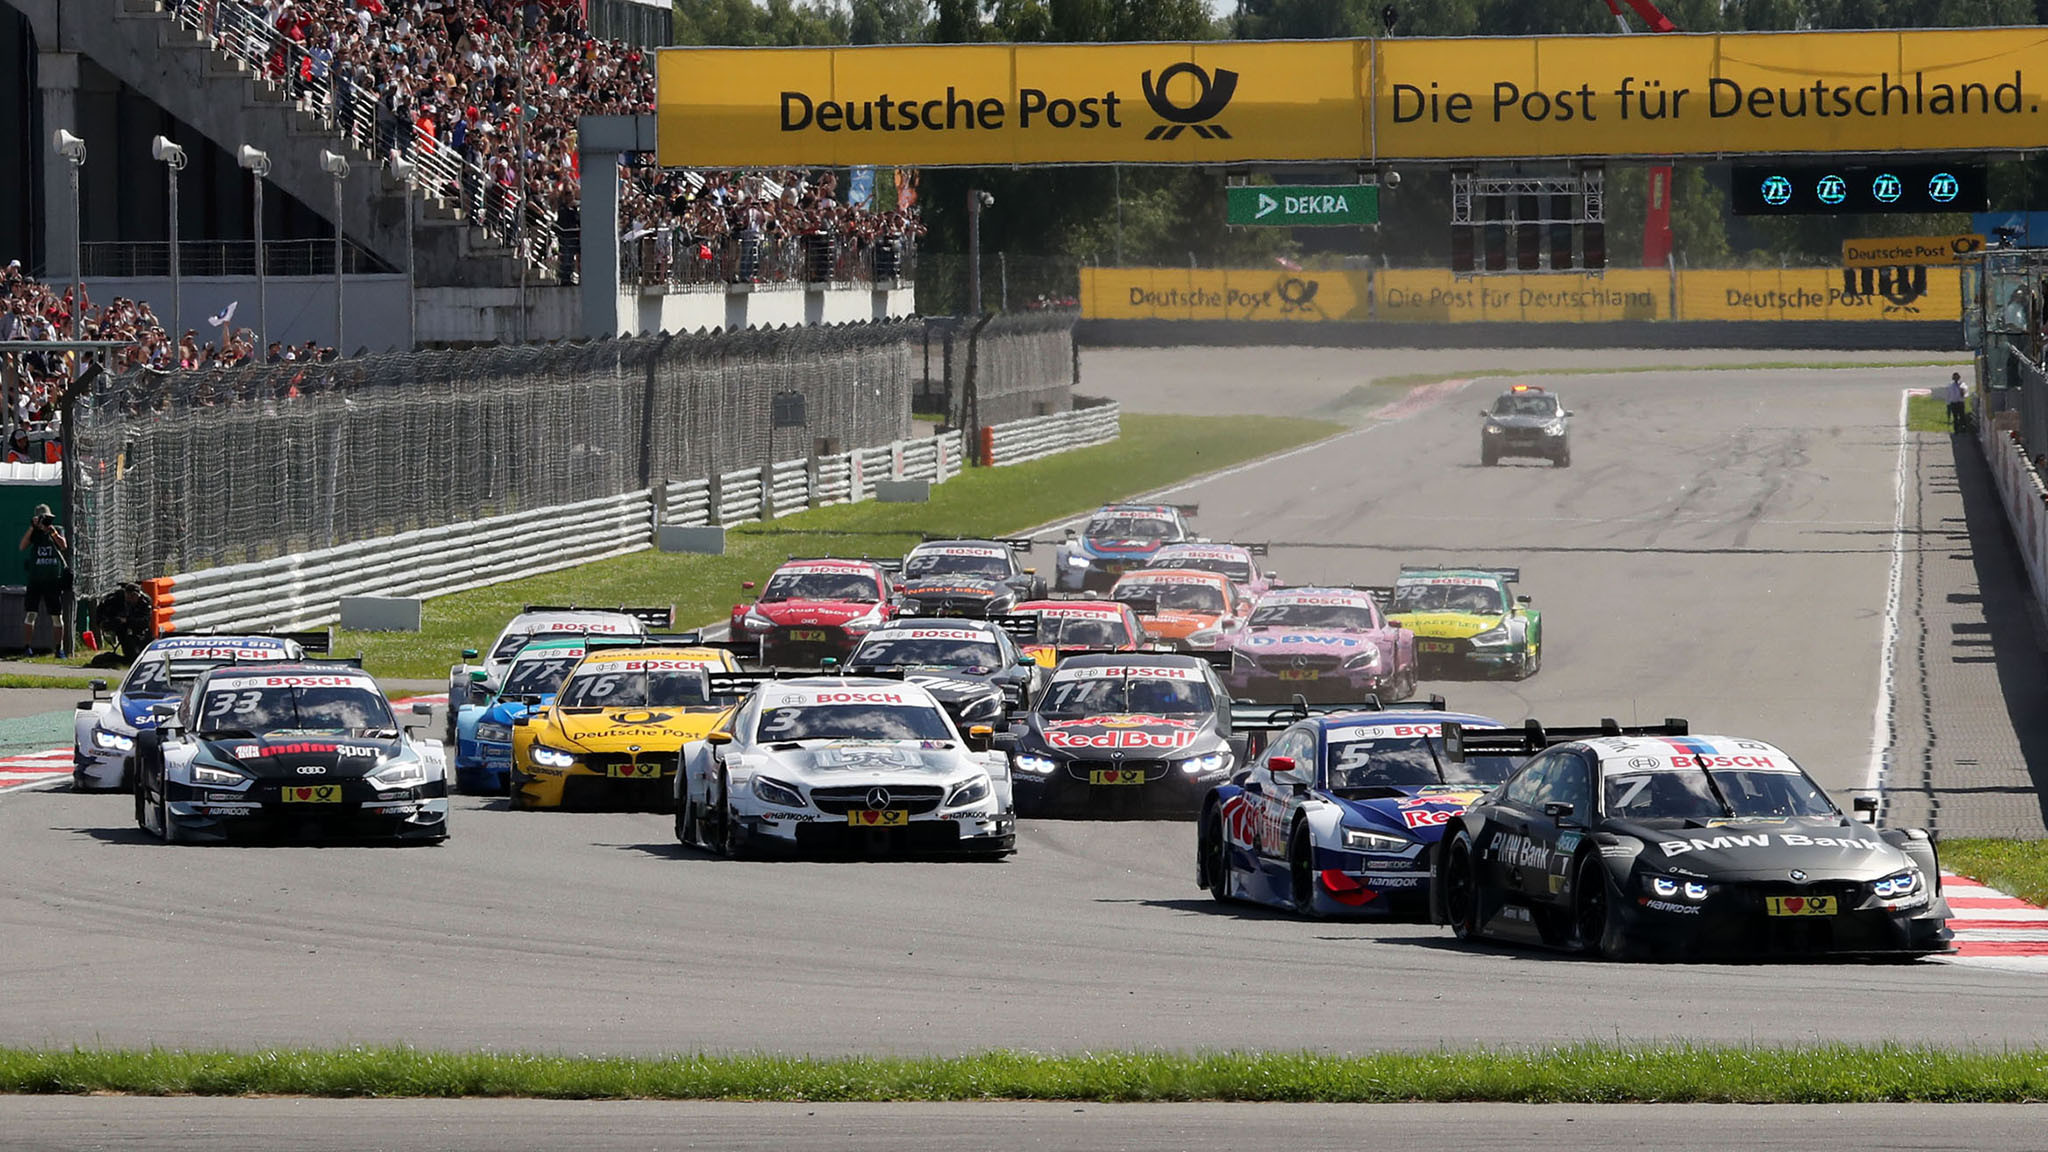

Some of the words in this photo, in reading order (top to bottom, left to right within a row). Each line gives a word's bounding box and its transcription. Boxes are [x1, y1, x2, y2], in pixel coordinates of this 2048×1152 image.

[1393, 81, 1473, 124] Die
[1493, 81, 1597, 123] Post
[1614, 74, 1690, 121] für
[1708, 70, 2040, 119] Deutschland.
[780, 86, 1005, 132] Deutsche
[1020, 88, 1122, 129] Post
[1285, 194, 1349, 215] DEKRA
[1847, 245, 1912, 261] Deutsche
[1915, 245, 1946, 258] Post
[1129, 286, 1221, 308] Deutsche
[1226, 287, 1272, 308] Post
[1387, 287, 1423, 309] Die
[1430, 287, 1473, 308] Post
[1481, 286, 1511, 308] für
[1519, 286, 1656, 309] Deutschland
[1726, 287, 1823, 309] Deutsche
[1829, 287, 1873, 307] Post
[945, 548, 993, 556] BOSCH
[907, 556, 940, 570] 63
[808, 567, 862, 575] BOSCH
[772, 575, 803, 589] 51
[1154, 576, 1207, 585] BOSCH
[1117, 586, 1150, 599] 53
[1395, 585, 1428, 600] 99
[1296, 597, 1352, 606] BOSCH
[817, 607, 853, 617] Sport
[1046, 609, 1108, 620] BOSCH
[1254, 606, 1290, 623] 22
[551, 623, 616, 632] BOSCH
[911, 630, 977, 639] BOSCH
[157, 639, 243, 649] SAMSUNG
[247, 640, 278, 649] SDI
[1281, 634, 1359, 647] BWT
[191, 648, 269, 659] BOSCH
[860, 642, 894, 659] 6
[625, 661, 705, 671] BOSCH
[1105, 667, 1185, 678] BOSCH
[266, 677, 352, 687] BOSCH
[575, 674, 621, 699] 16
[816, 693, 903, 704] BOSCH
[1053, 681, 1097, 705] 11
[207, 691, 263, 717] 33
[764, 708, 802, 732] 3
[573, 728, 658, 741] Deutsche
[662, 728, 701, 739] Post
[1044, 730, 1118, 748] Red
[1121, 730, 1198, 748] Bull
[1335, 742, 1376, 771] 5
[1670, 755, 1775, 769] BOSCH
[1614, 775, 1653, 809] 7
[1490, 831, 1521, 864] BMW
[1519, 837, 1550, 870] Bank
[1659, 834, 1770, 857] BMW
[1780, 834, 1889, 854] Bank
